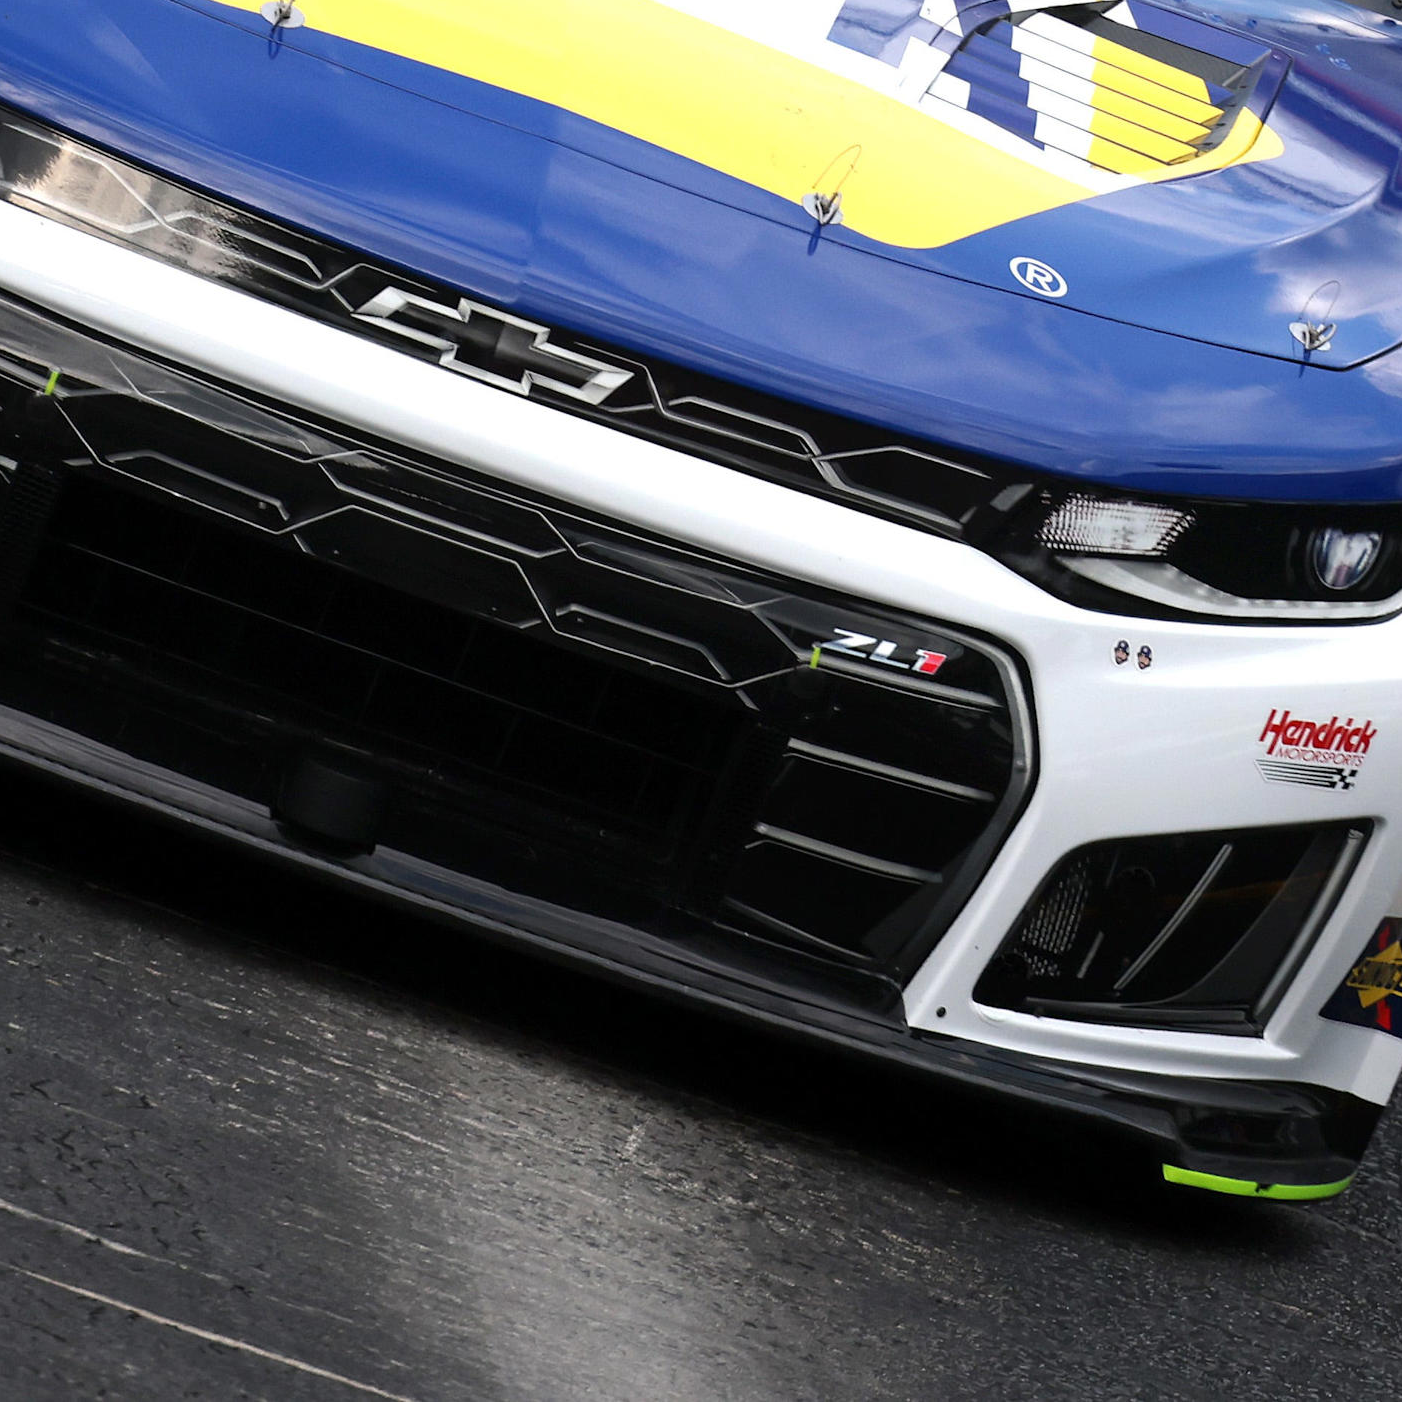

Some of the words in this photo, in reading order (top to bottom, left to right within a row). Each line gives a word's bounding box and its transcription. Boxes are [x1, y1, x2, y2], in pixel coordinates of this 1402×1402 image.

[820, 628, 948, 675] ZL1
[1258, 708, 1378, 755] Hendrick
[1276, 748, 1365, 767] MOTORSPORTS
